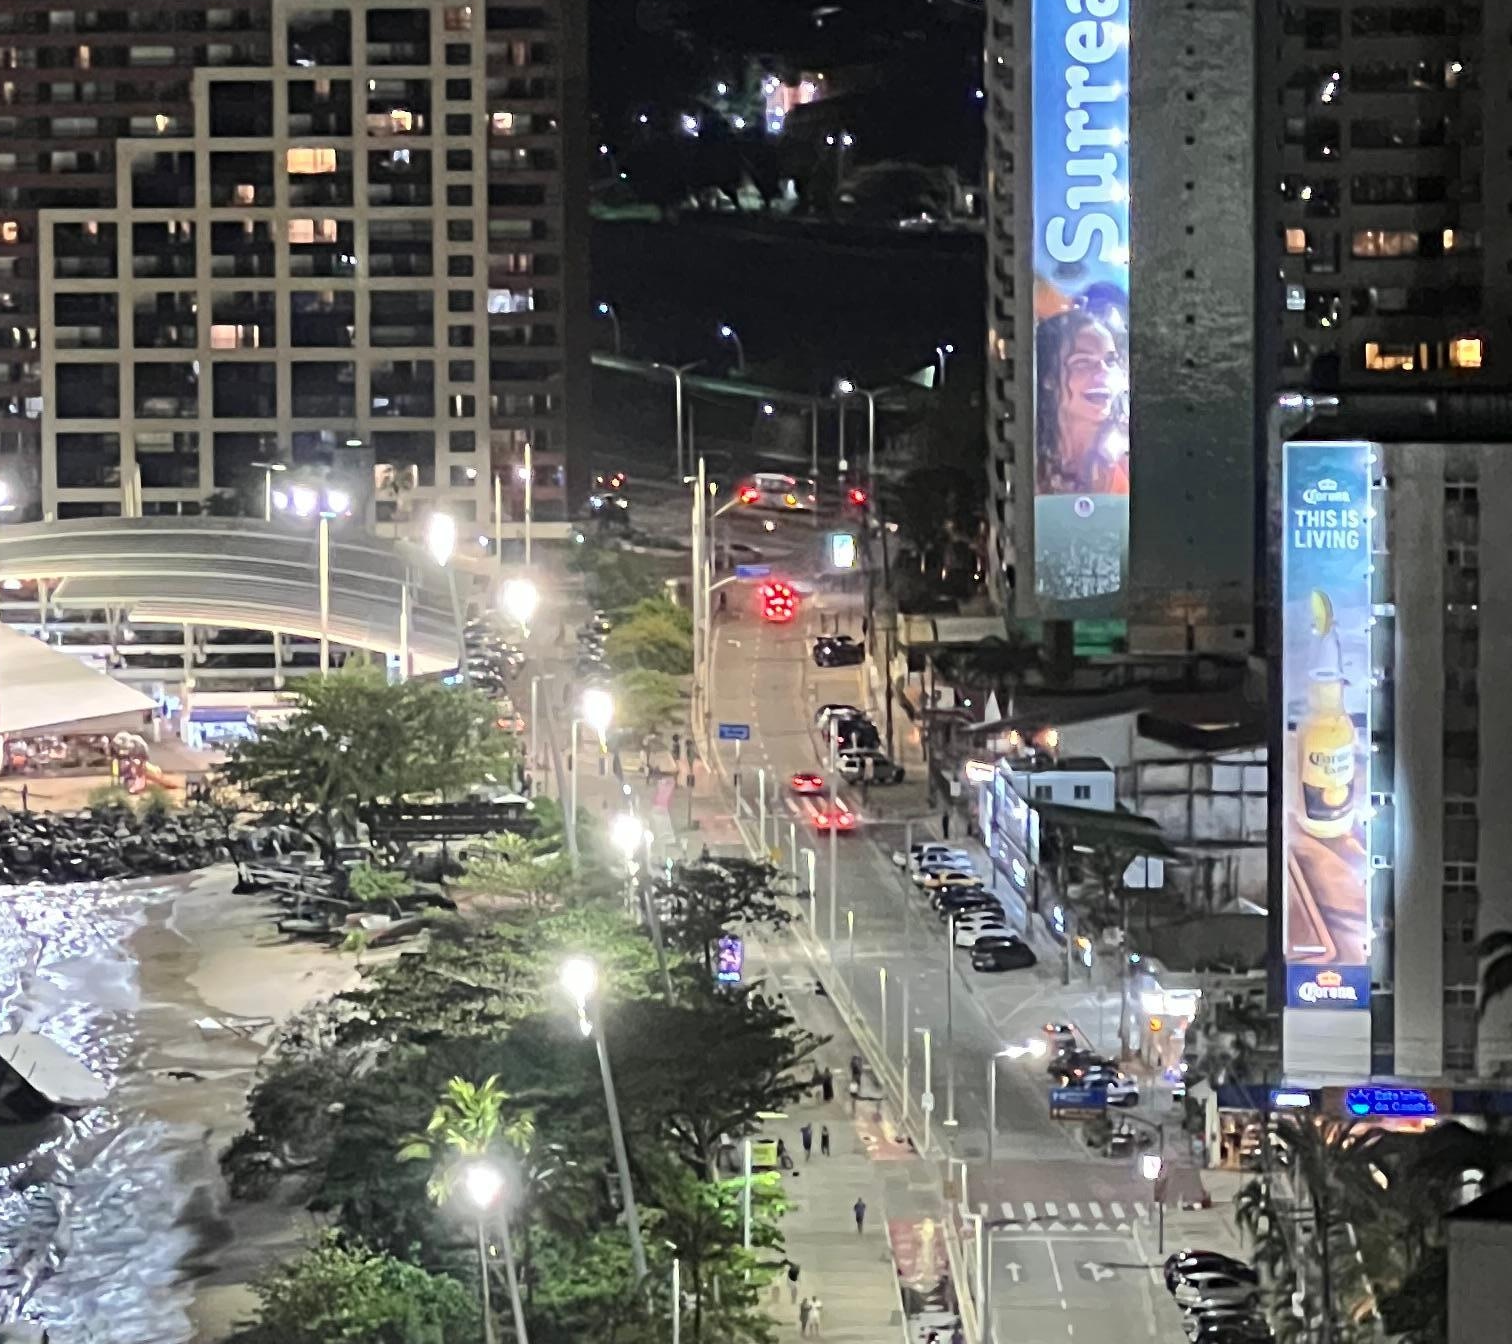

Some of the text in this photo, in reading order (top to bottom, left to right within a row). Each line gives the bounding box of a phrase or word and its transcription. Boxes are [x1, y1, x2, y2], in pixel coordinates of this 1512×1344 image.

[1294, 509, 1360, 529] THIS IS
[1294, 529, 1360, 550] LIVING
[1298, 981, 1358, 1003] Corona
